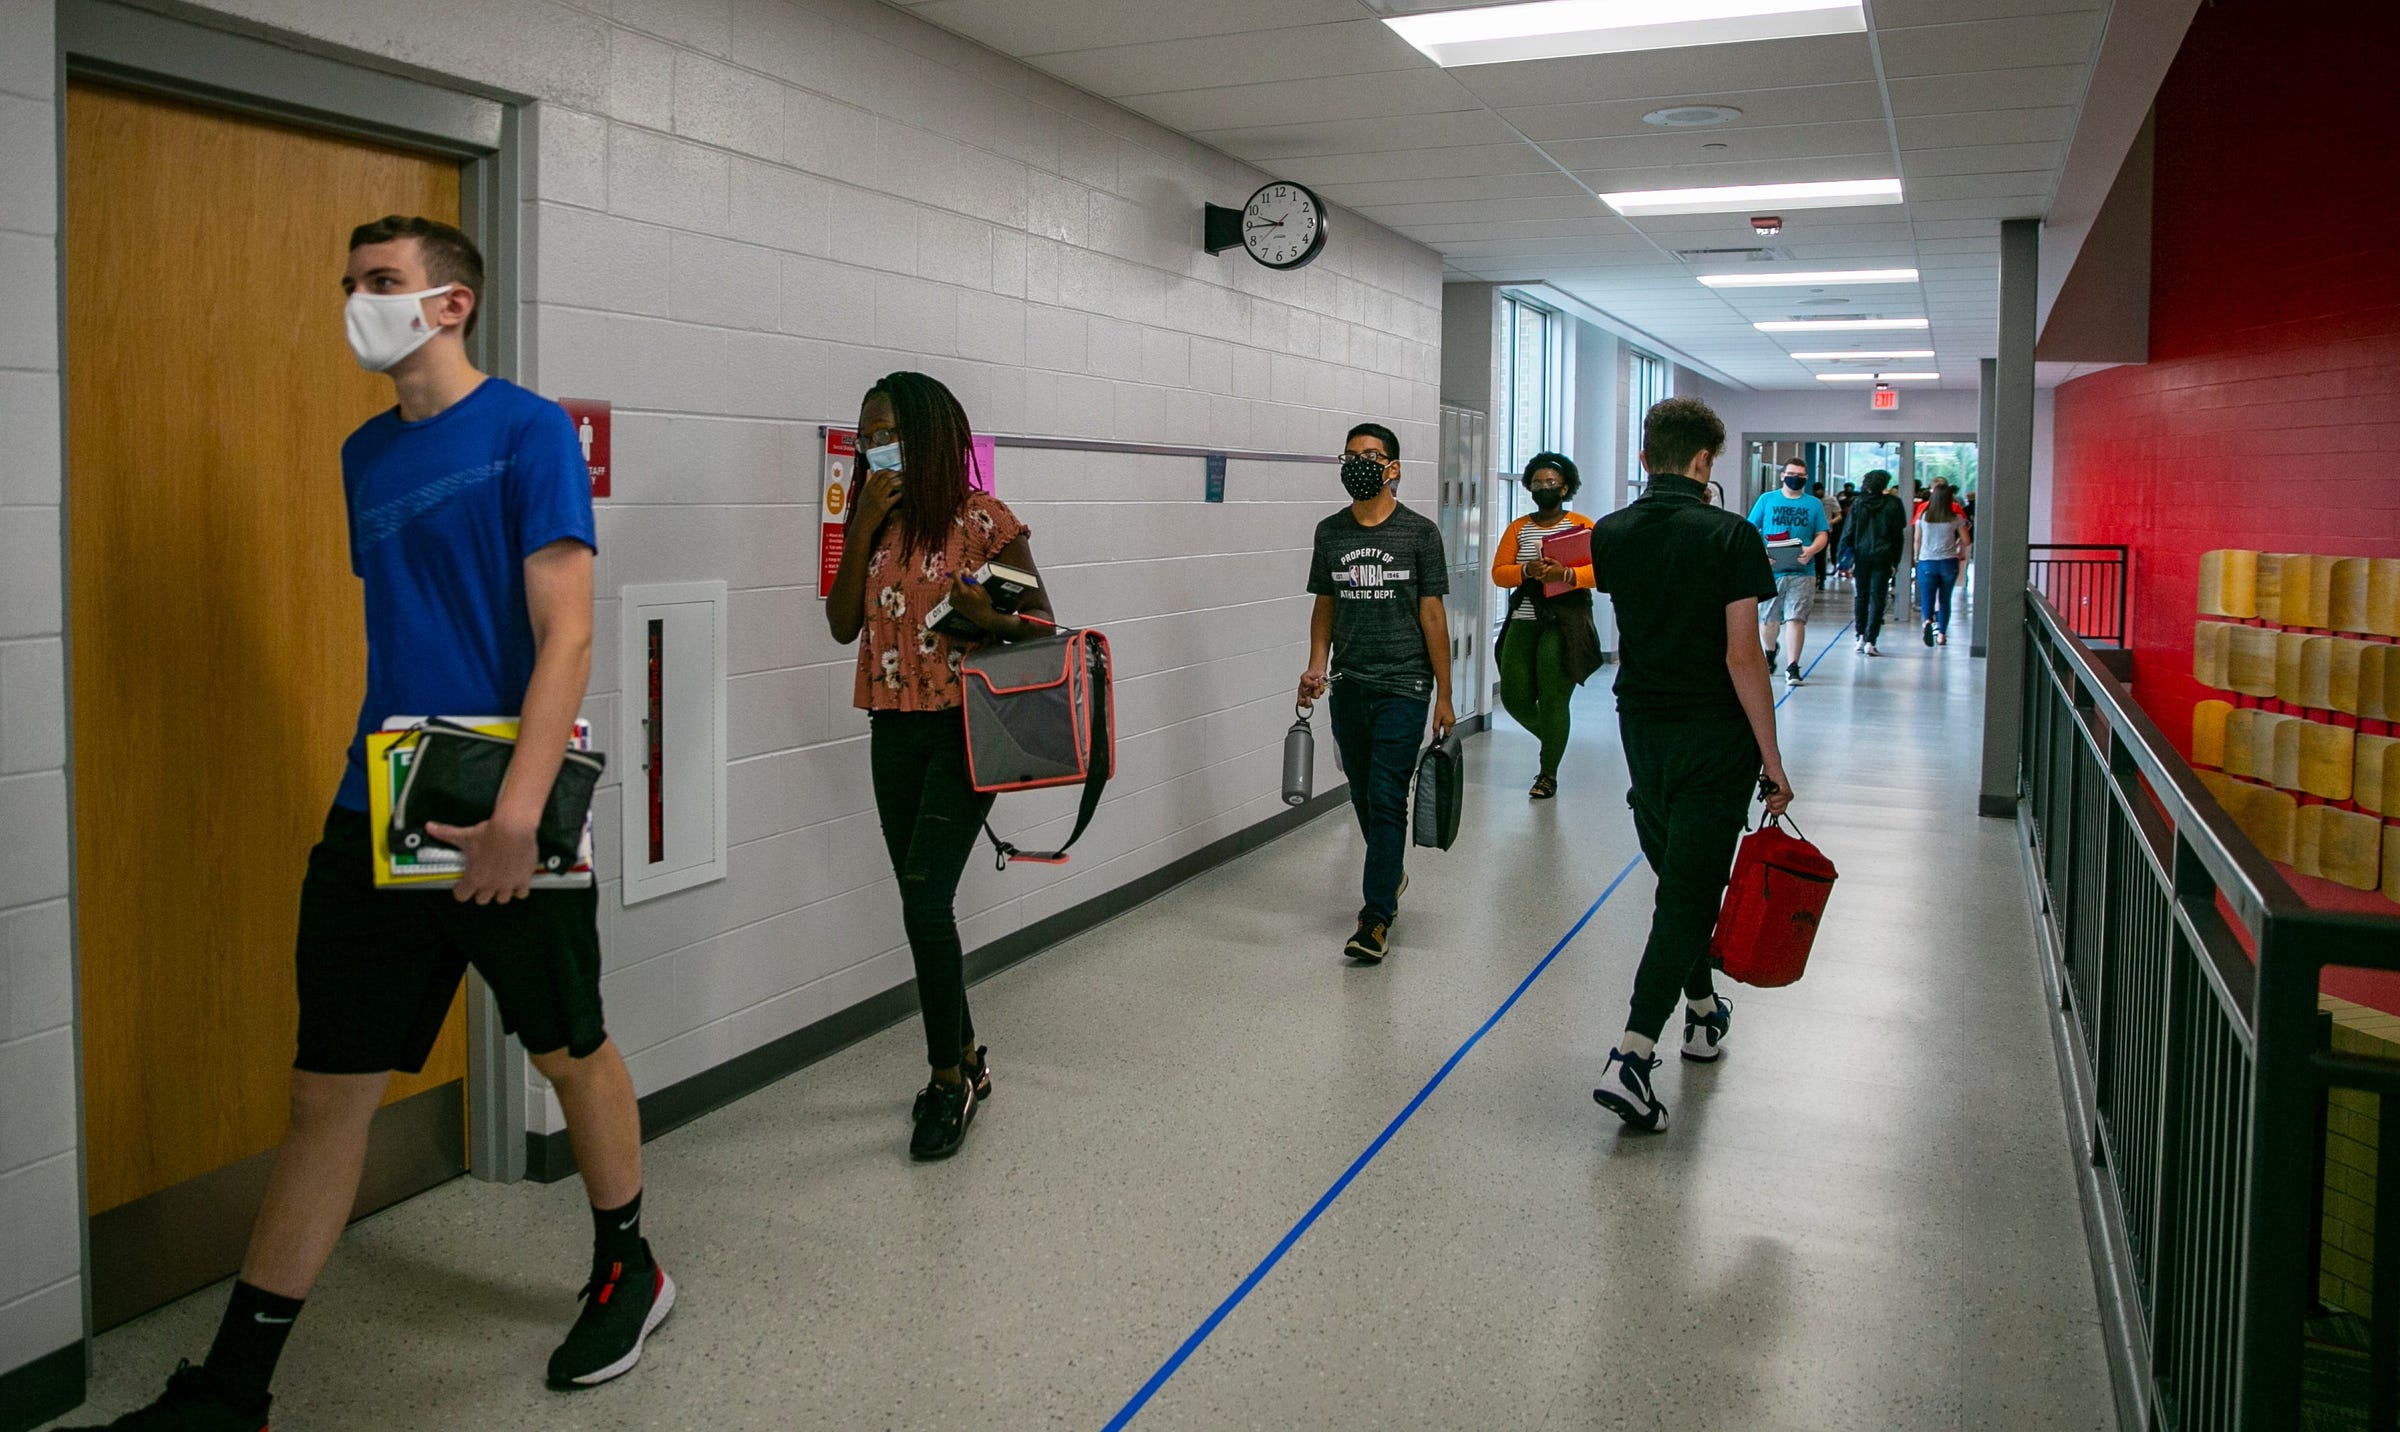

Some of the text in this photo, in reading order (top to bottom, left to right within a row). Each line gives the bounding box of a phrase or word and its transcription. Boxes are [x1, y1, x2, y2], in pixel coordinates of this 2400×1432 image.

[1275, 187, 1286, 198] 12
[1292, 192, 1297, 202] 1
[1262, 193, 1270, 204] 11
[1249, 205, 1259, 216] 10
[1302, 202, 1310, 213] 2
[1246, 221, 1253, 232] 9
[1307, 218, 1314, 228] 3
[1250, 236, 1256, 246] 8
[1302, 233, 1309, 244] 4
[1261, 248, 1269, 258] 7
[1276, 250, 1283, 261] 6
[1291, 246, 1297, 257] 5
[1874, 392, 1896, 408] EXIT
[588, 466, 606, 476] TAFF
[1772, 506, 1809, 516] WREAK
[1772, 516, 1809, 526] HAVOC
[1340, 548, 1394, 565] PROPERTY OF
[1360, 565, 1384, 586] NBA
[1340, 590, 1396, 599] ATHLETIC DEPT.
